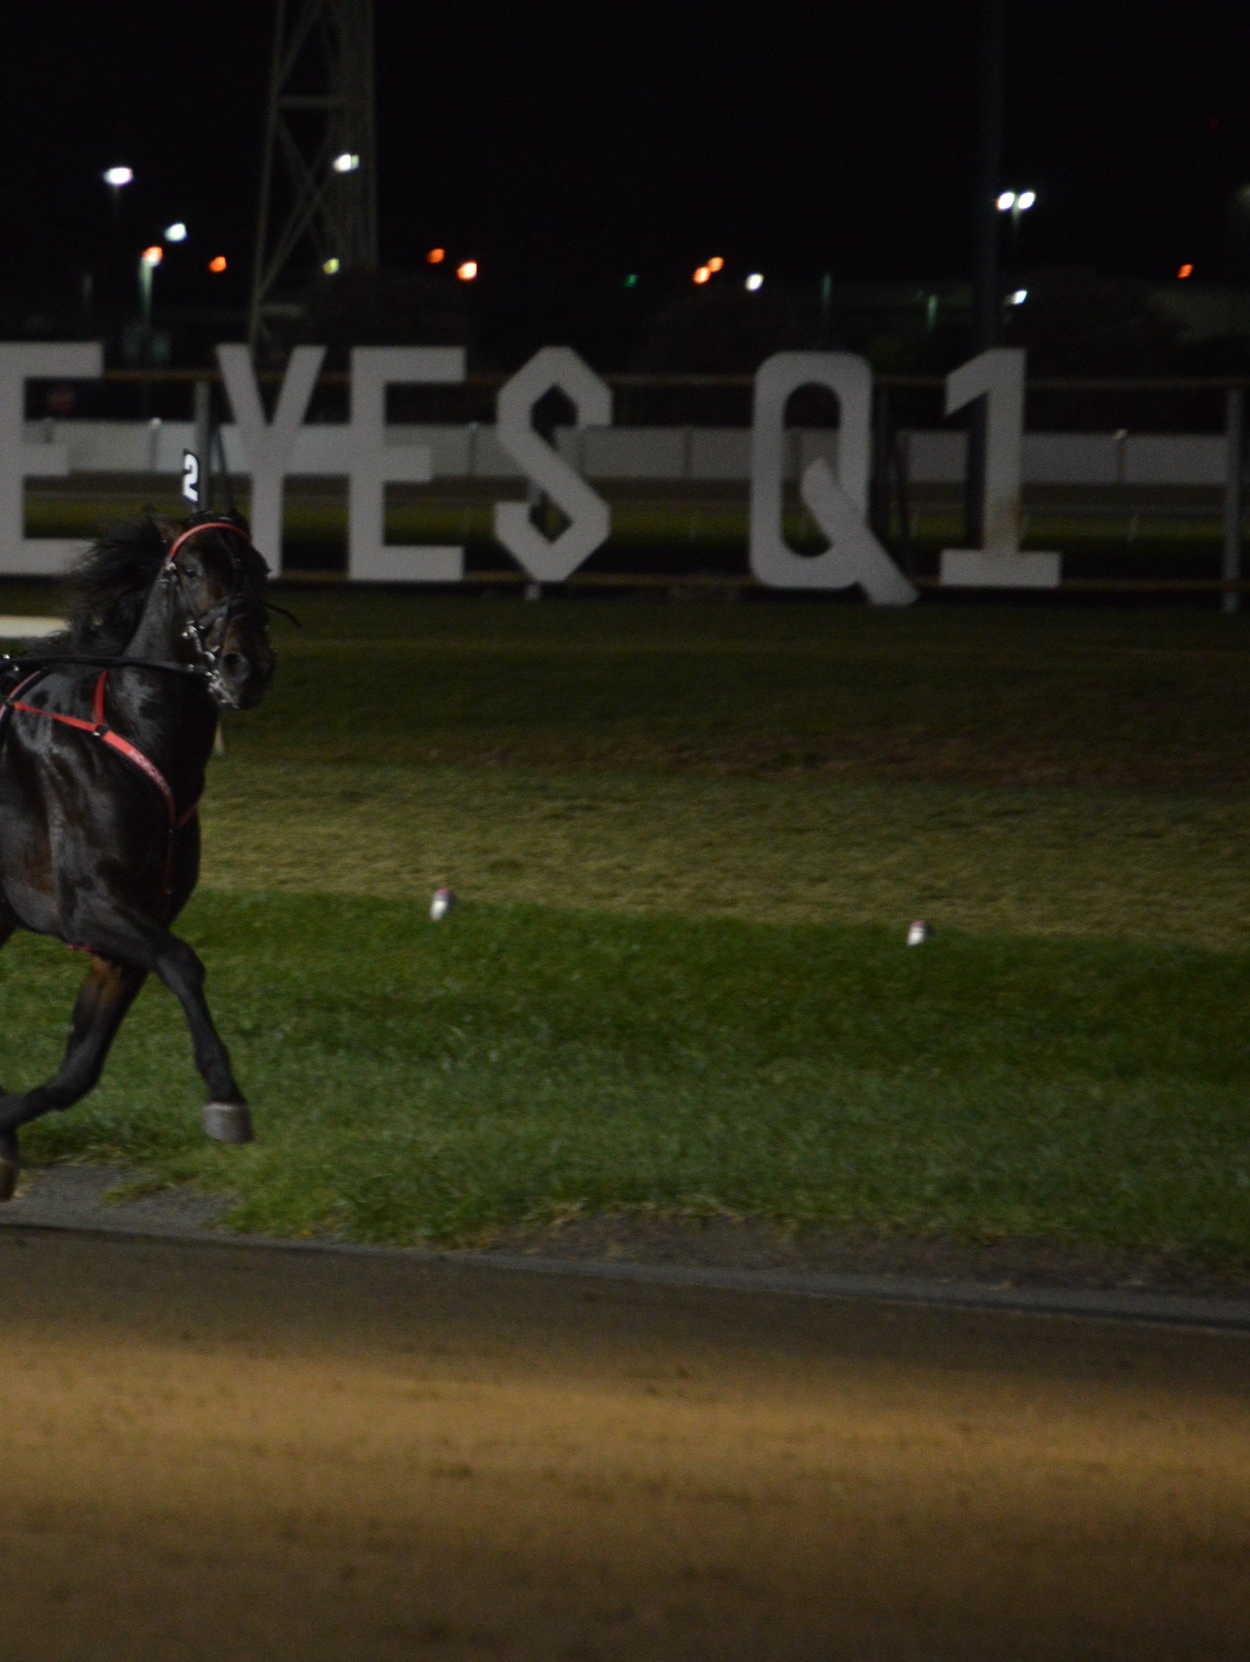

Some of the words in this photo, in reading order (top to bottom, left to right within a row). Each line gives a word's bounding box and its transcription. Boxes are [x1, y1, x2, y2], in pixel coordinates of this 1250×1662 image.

[183, 453, 199, 502] 2
[217, 345, 612, 582] YES
[753, 348, 1062, 606] Q1
